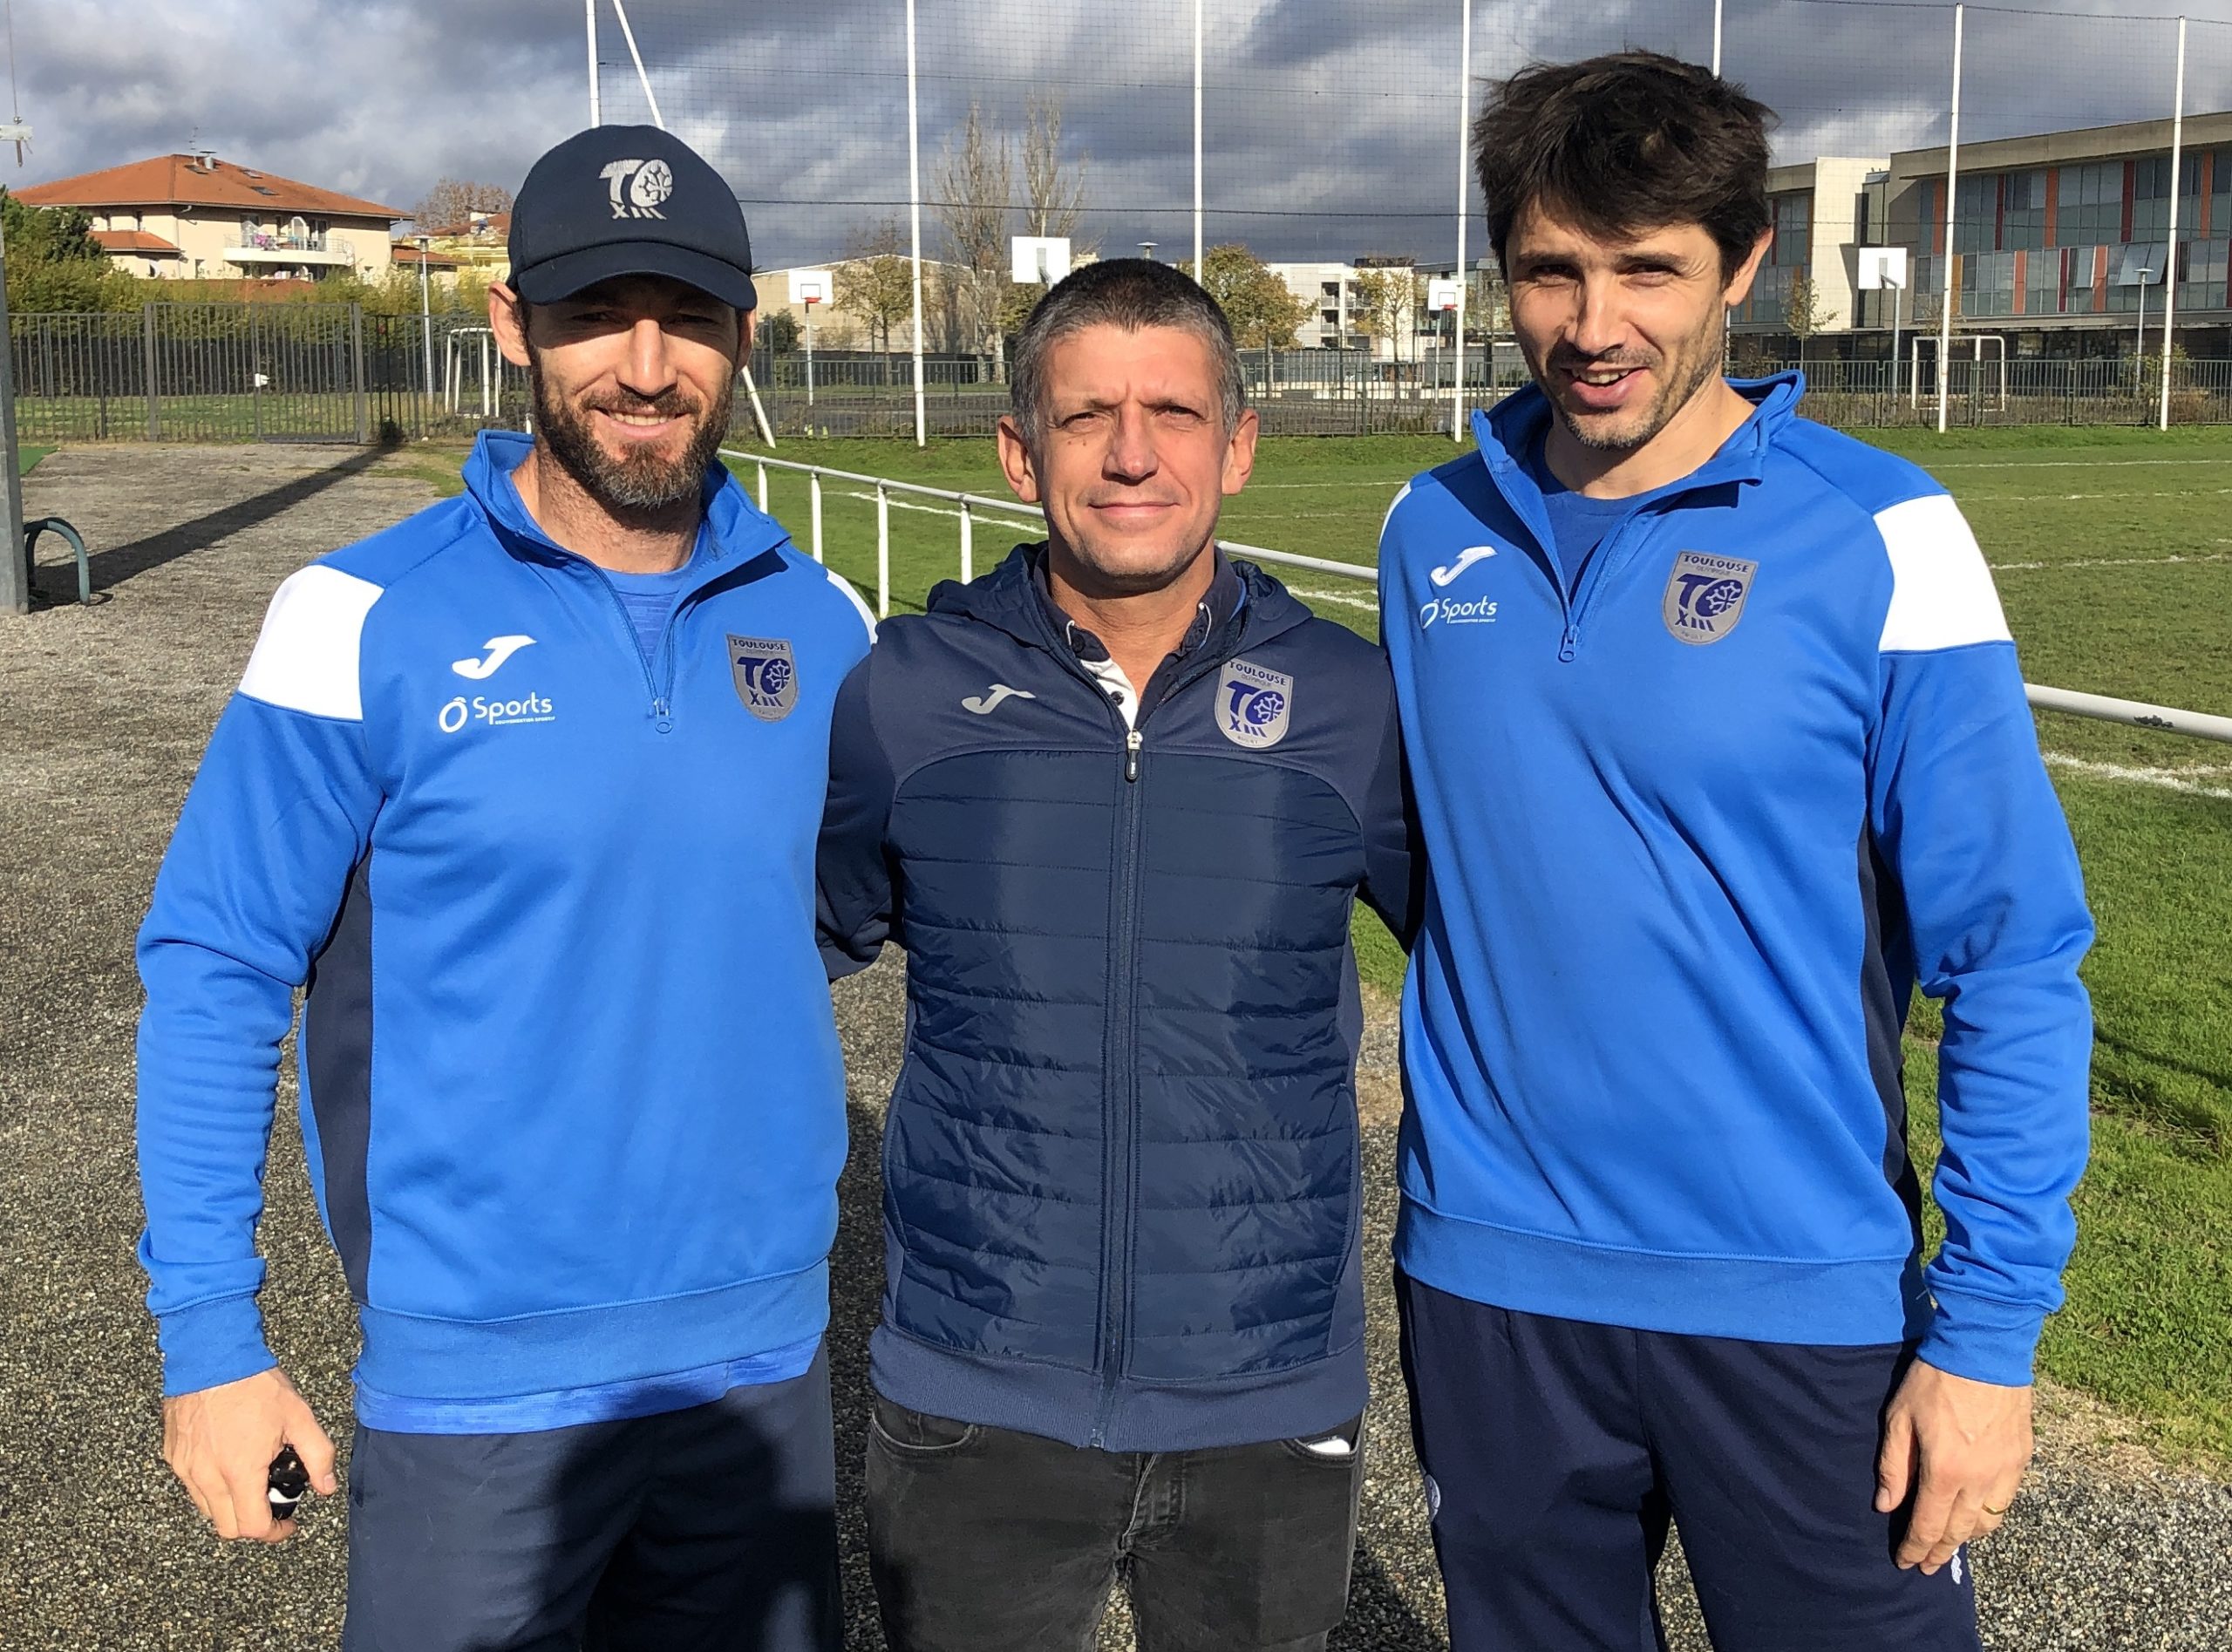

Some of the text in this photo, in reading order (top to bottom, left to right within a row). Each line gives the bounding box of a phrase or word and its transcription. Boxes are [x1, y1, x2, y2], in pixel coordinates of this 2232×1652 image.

[1684, 554, 1749, 573] TOULOUSE
[1440, 595, 1498, 623] Sports
[732, 639, 787, 651] TOULOUSE
[1229, 660, 1287, 686] TOULOUSE
[473, 691, 553, 725] Sports
